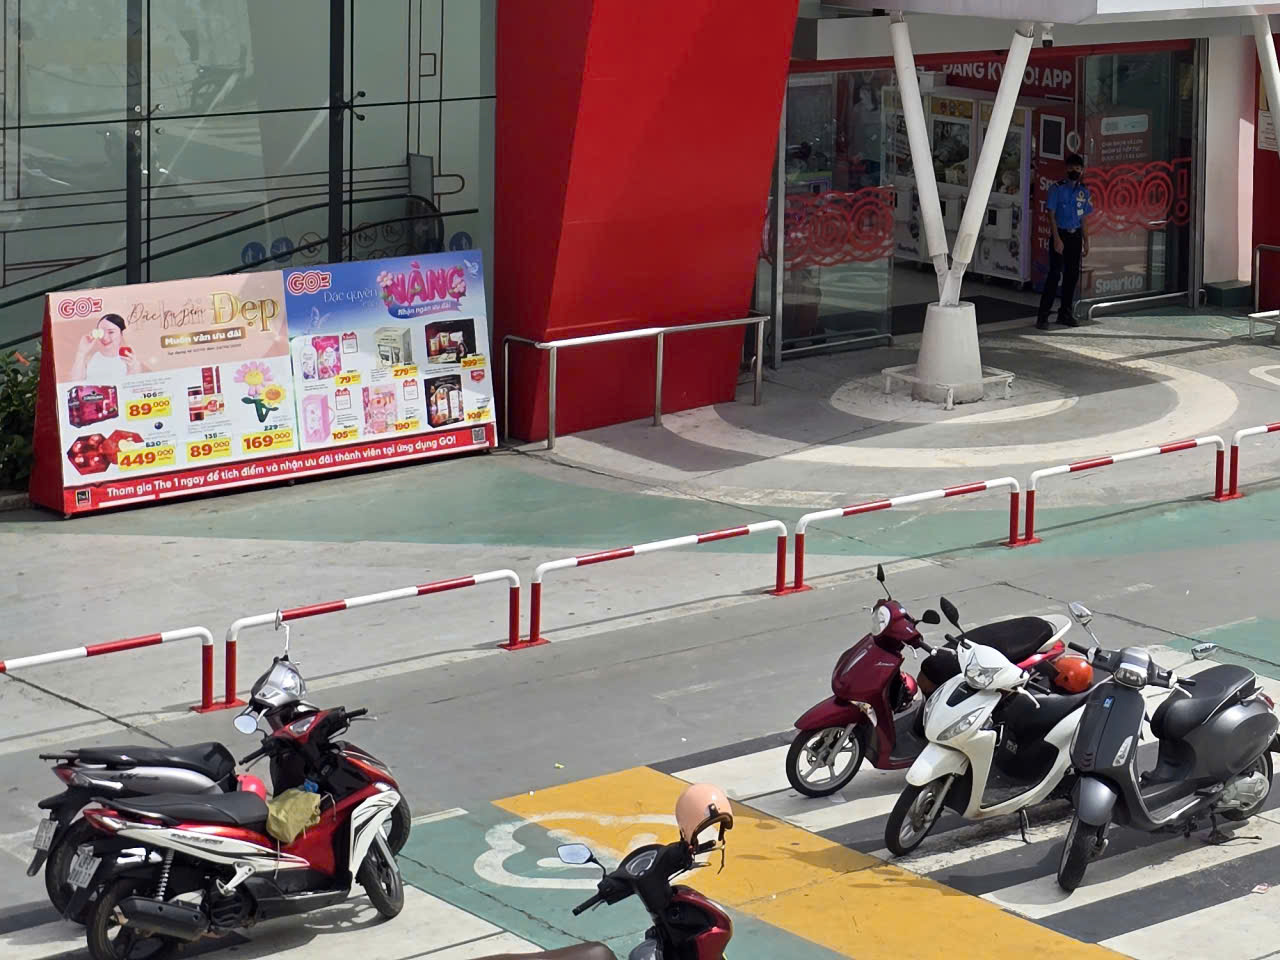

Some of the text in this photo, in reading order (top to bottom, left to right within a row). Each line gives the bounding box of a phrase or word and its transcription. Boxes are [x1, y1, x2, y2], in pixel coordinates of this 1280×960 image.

[1041, 68, 1072, 88] APP
[211, 291, 279, 332] Đẹp
[129, 403, 152, 417] 89
[244, 434, 273, 450] 169
[190, 443, 213, 458] 89
[107, 486, 135, 497] Tham
[137, 483, 152, 495] gia
[154, 479, 172, 490] The
[174, 478, 179, 487] 1
[181, 475, 204, 487] ngay
[266, 463, 278, 472] và
[280, 458, 303, 471] nhận
[363, 446, 381, 457] viên
[439, 435, 456, 446] GO!
[119, 451, 156, 467] 449
